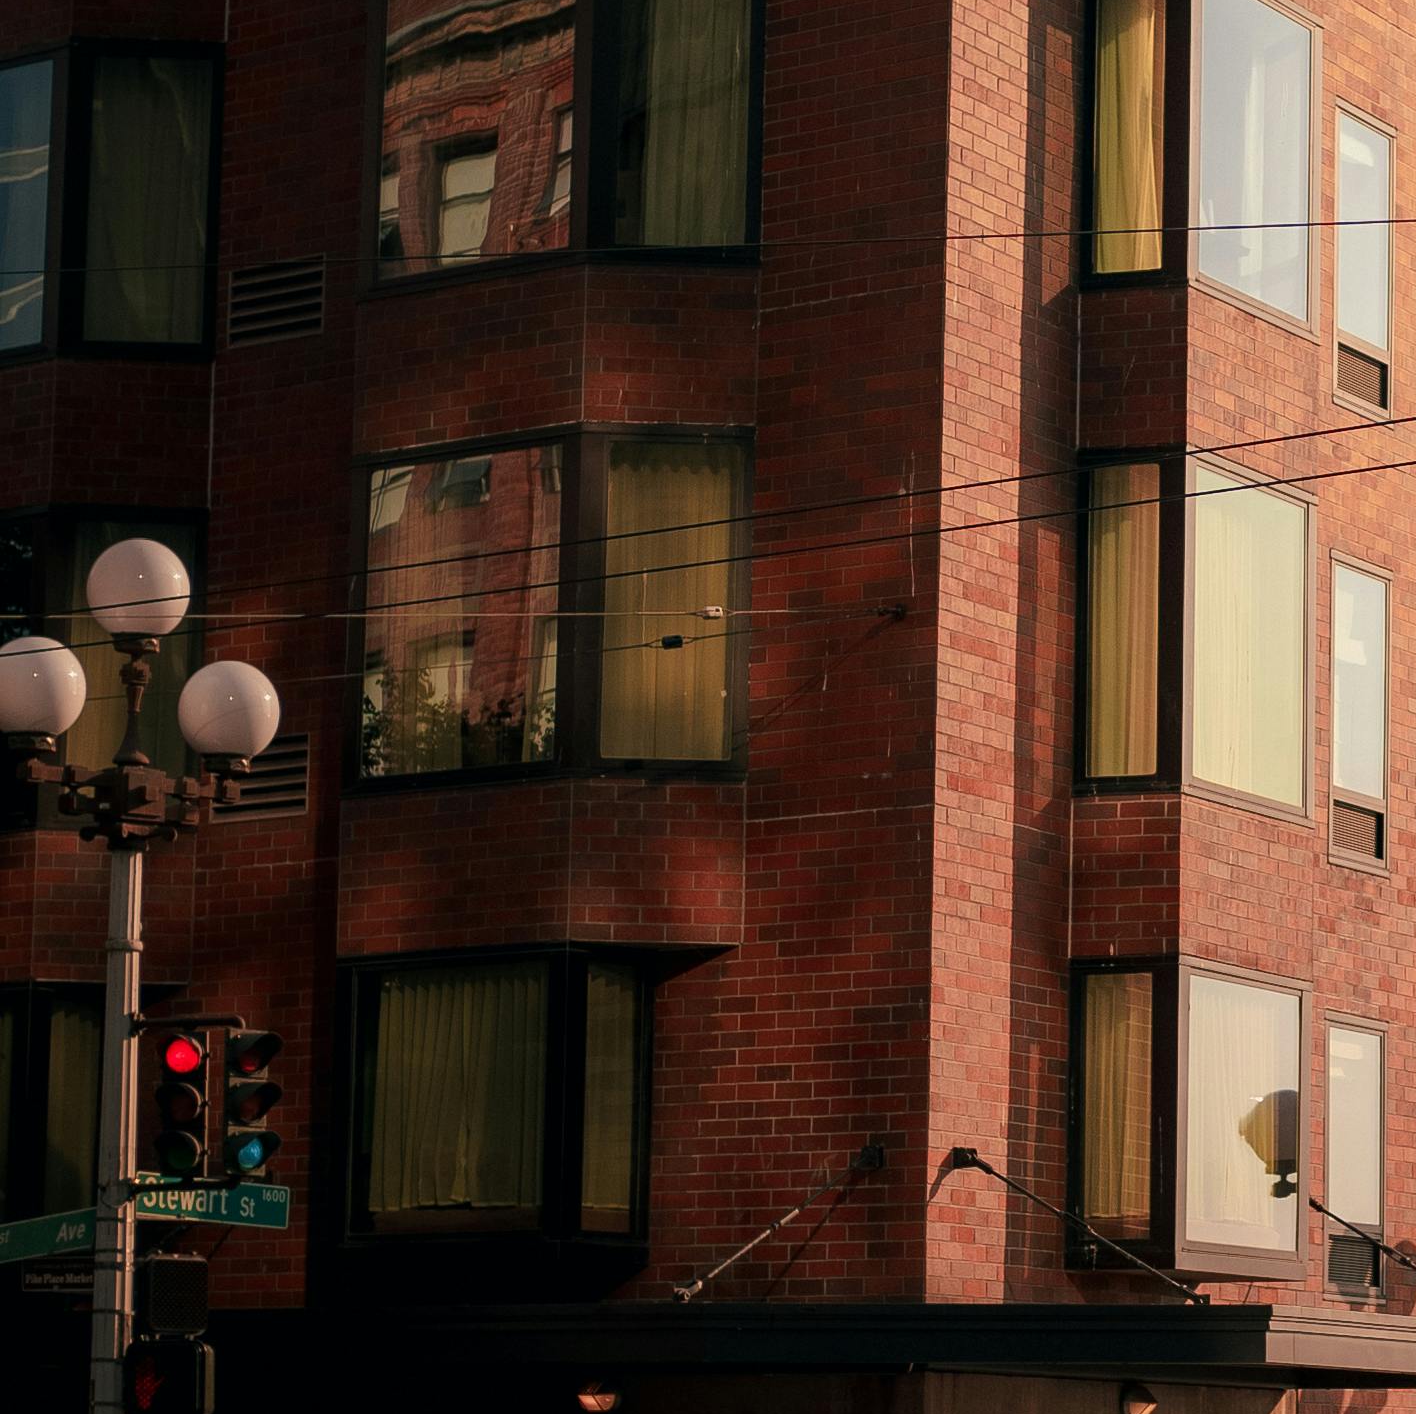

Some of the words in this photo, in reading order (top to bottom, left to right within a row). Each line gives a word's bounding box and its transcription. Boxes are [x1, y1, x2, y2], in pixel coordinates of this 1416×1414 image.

[143, 1176, 230, 1215] Stewart
[240, 1196, 256, 1218] St
[262, 1189, 286, 1203] 1600
[56, 1221, 86, 1243] Ave
